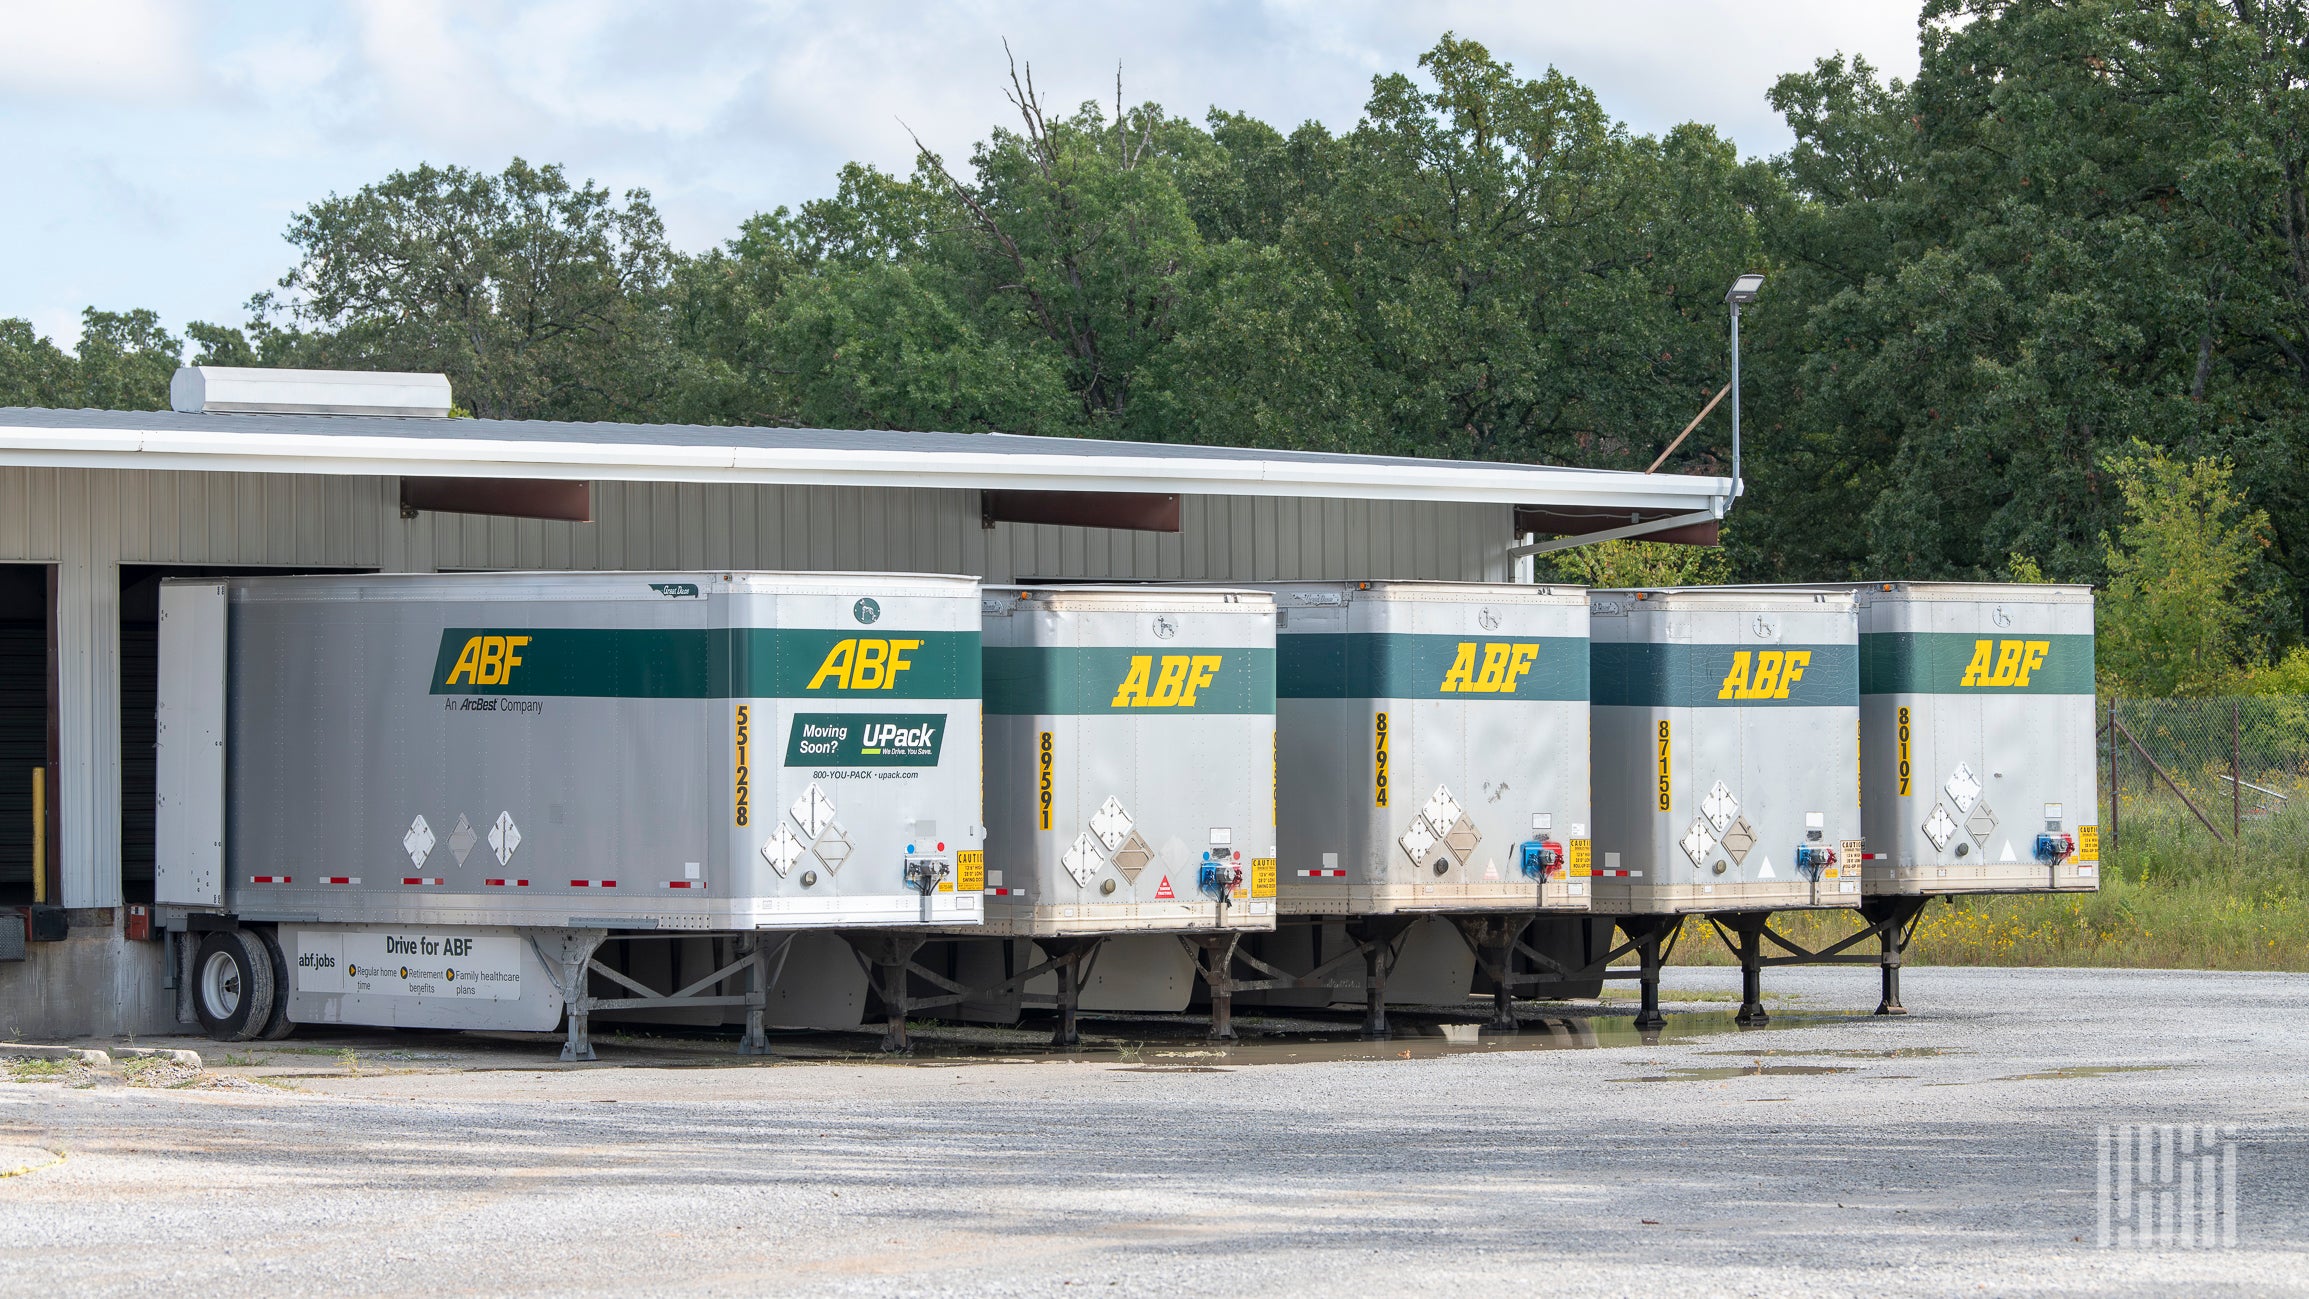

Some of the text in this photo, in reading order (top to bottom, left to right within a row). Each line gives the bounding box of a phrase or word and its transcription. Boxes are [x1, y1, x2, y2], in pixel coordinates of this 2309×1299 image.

[445, 635, 530, 685] ABF
[806, 638, 921, 690] ABF
[1439, 642, 1540, 693] ABF
[1960, 639, 2050, 687] ABF
[1111, 655, 1223, 707] ABF
[1717, 650, 1812, 700] ABF
[445, 698, 544, 715] An ArcBest Company
[803, 724, 848, 740] Moving
[800, 740, 839, 754] Soon?
[1898, 707, 1910, 795] 80107
[736, 705, 748, 826] 551228
[1376, 713, 1388, 806] 87964
[1659, 720, 1670, 811] 87159
[812, 770, 919, 780] 800-YOU-PACK upack.com
[1041, 732, 1052, 829] 89591
[386, 935, 473, 957] Drive for ABF
[298, 953, 336, 971] abf.jobs
[357, 966, 398, 978] Regular home
[409, 968, 444, 980] Retirement
[455, 970, 520, 983] Family healthcare
[357, 980, 371, 991] time
[409, 982, 436, 994] benefits
[456, 984, 476, 996] plans
